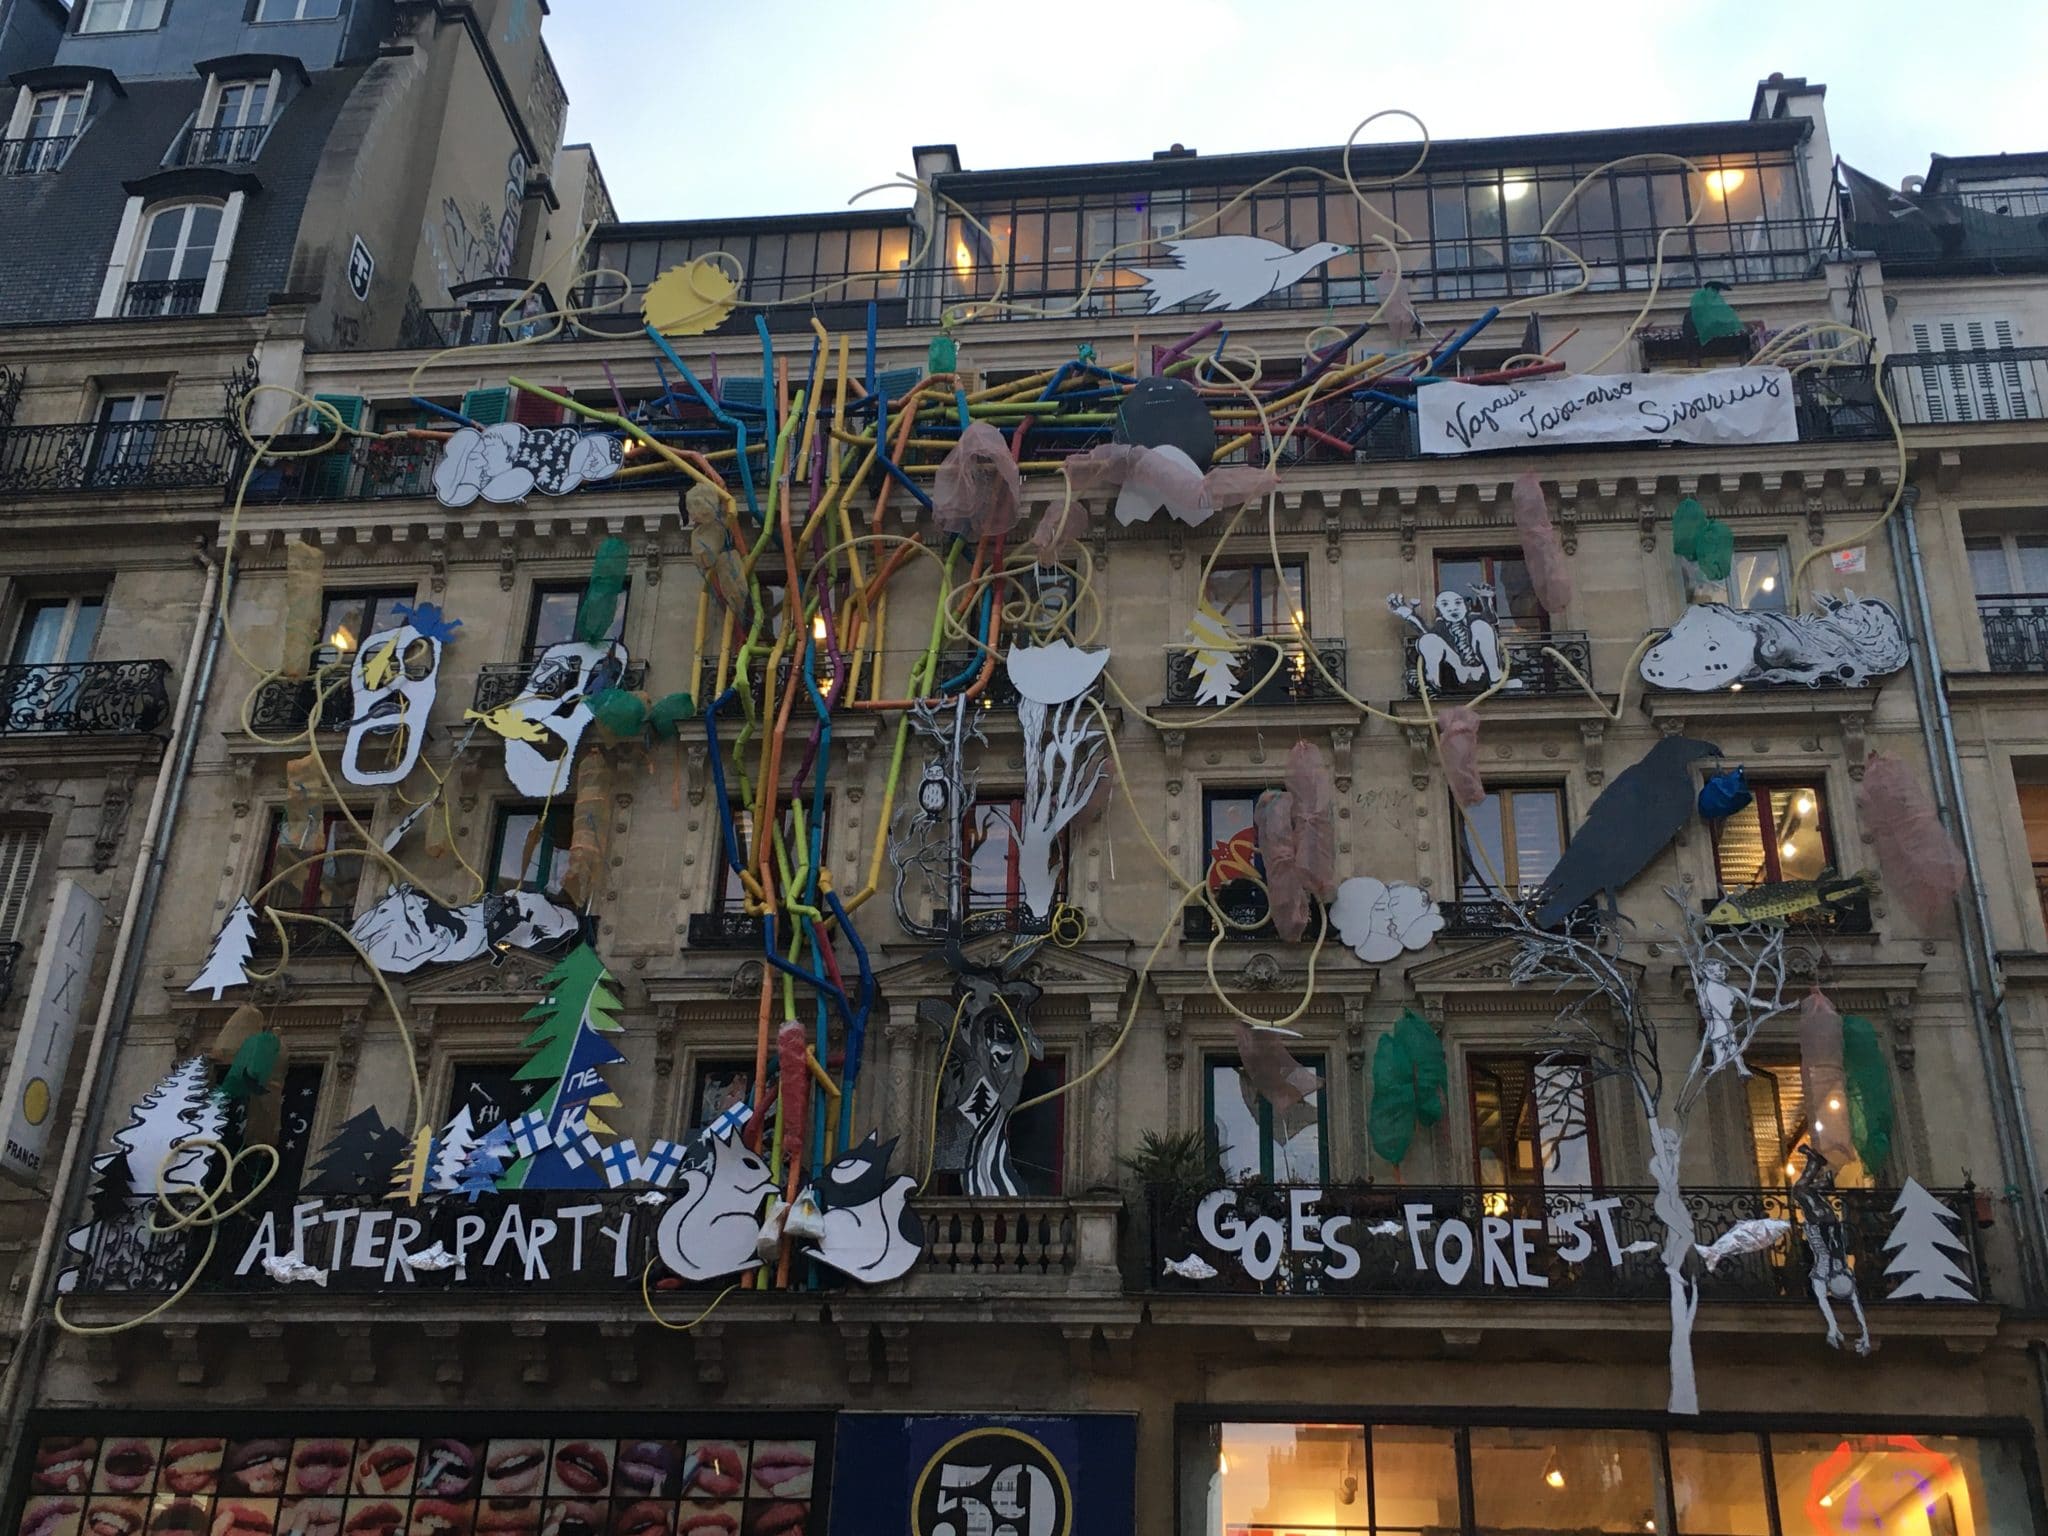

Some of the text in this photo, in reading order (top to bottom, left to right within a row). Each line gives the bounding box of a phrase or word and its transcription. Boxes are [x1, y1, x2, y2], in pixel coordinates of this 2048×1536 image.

[6, 1139, 40, 1170] FRANCE
[234, 1199, 630, 1283] AFTER PARTY
[1196, 1189, 1622, 1288] GOES FOREST
[931, 1464, 1057, 1536] 59
